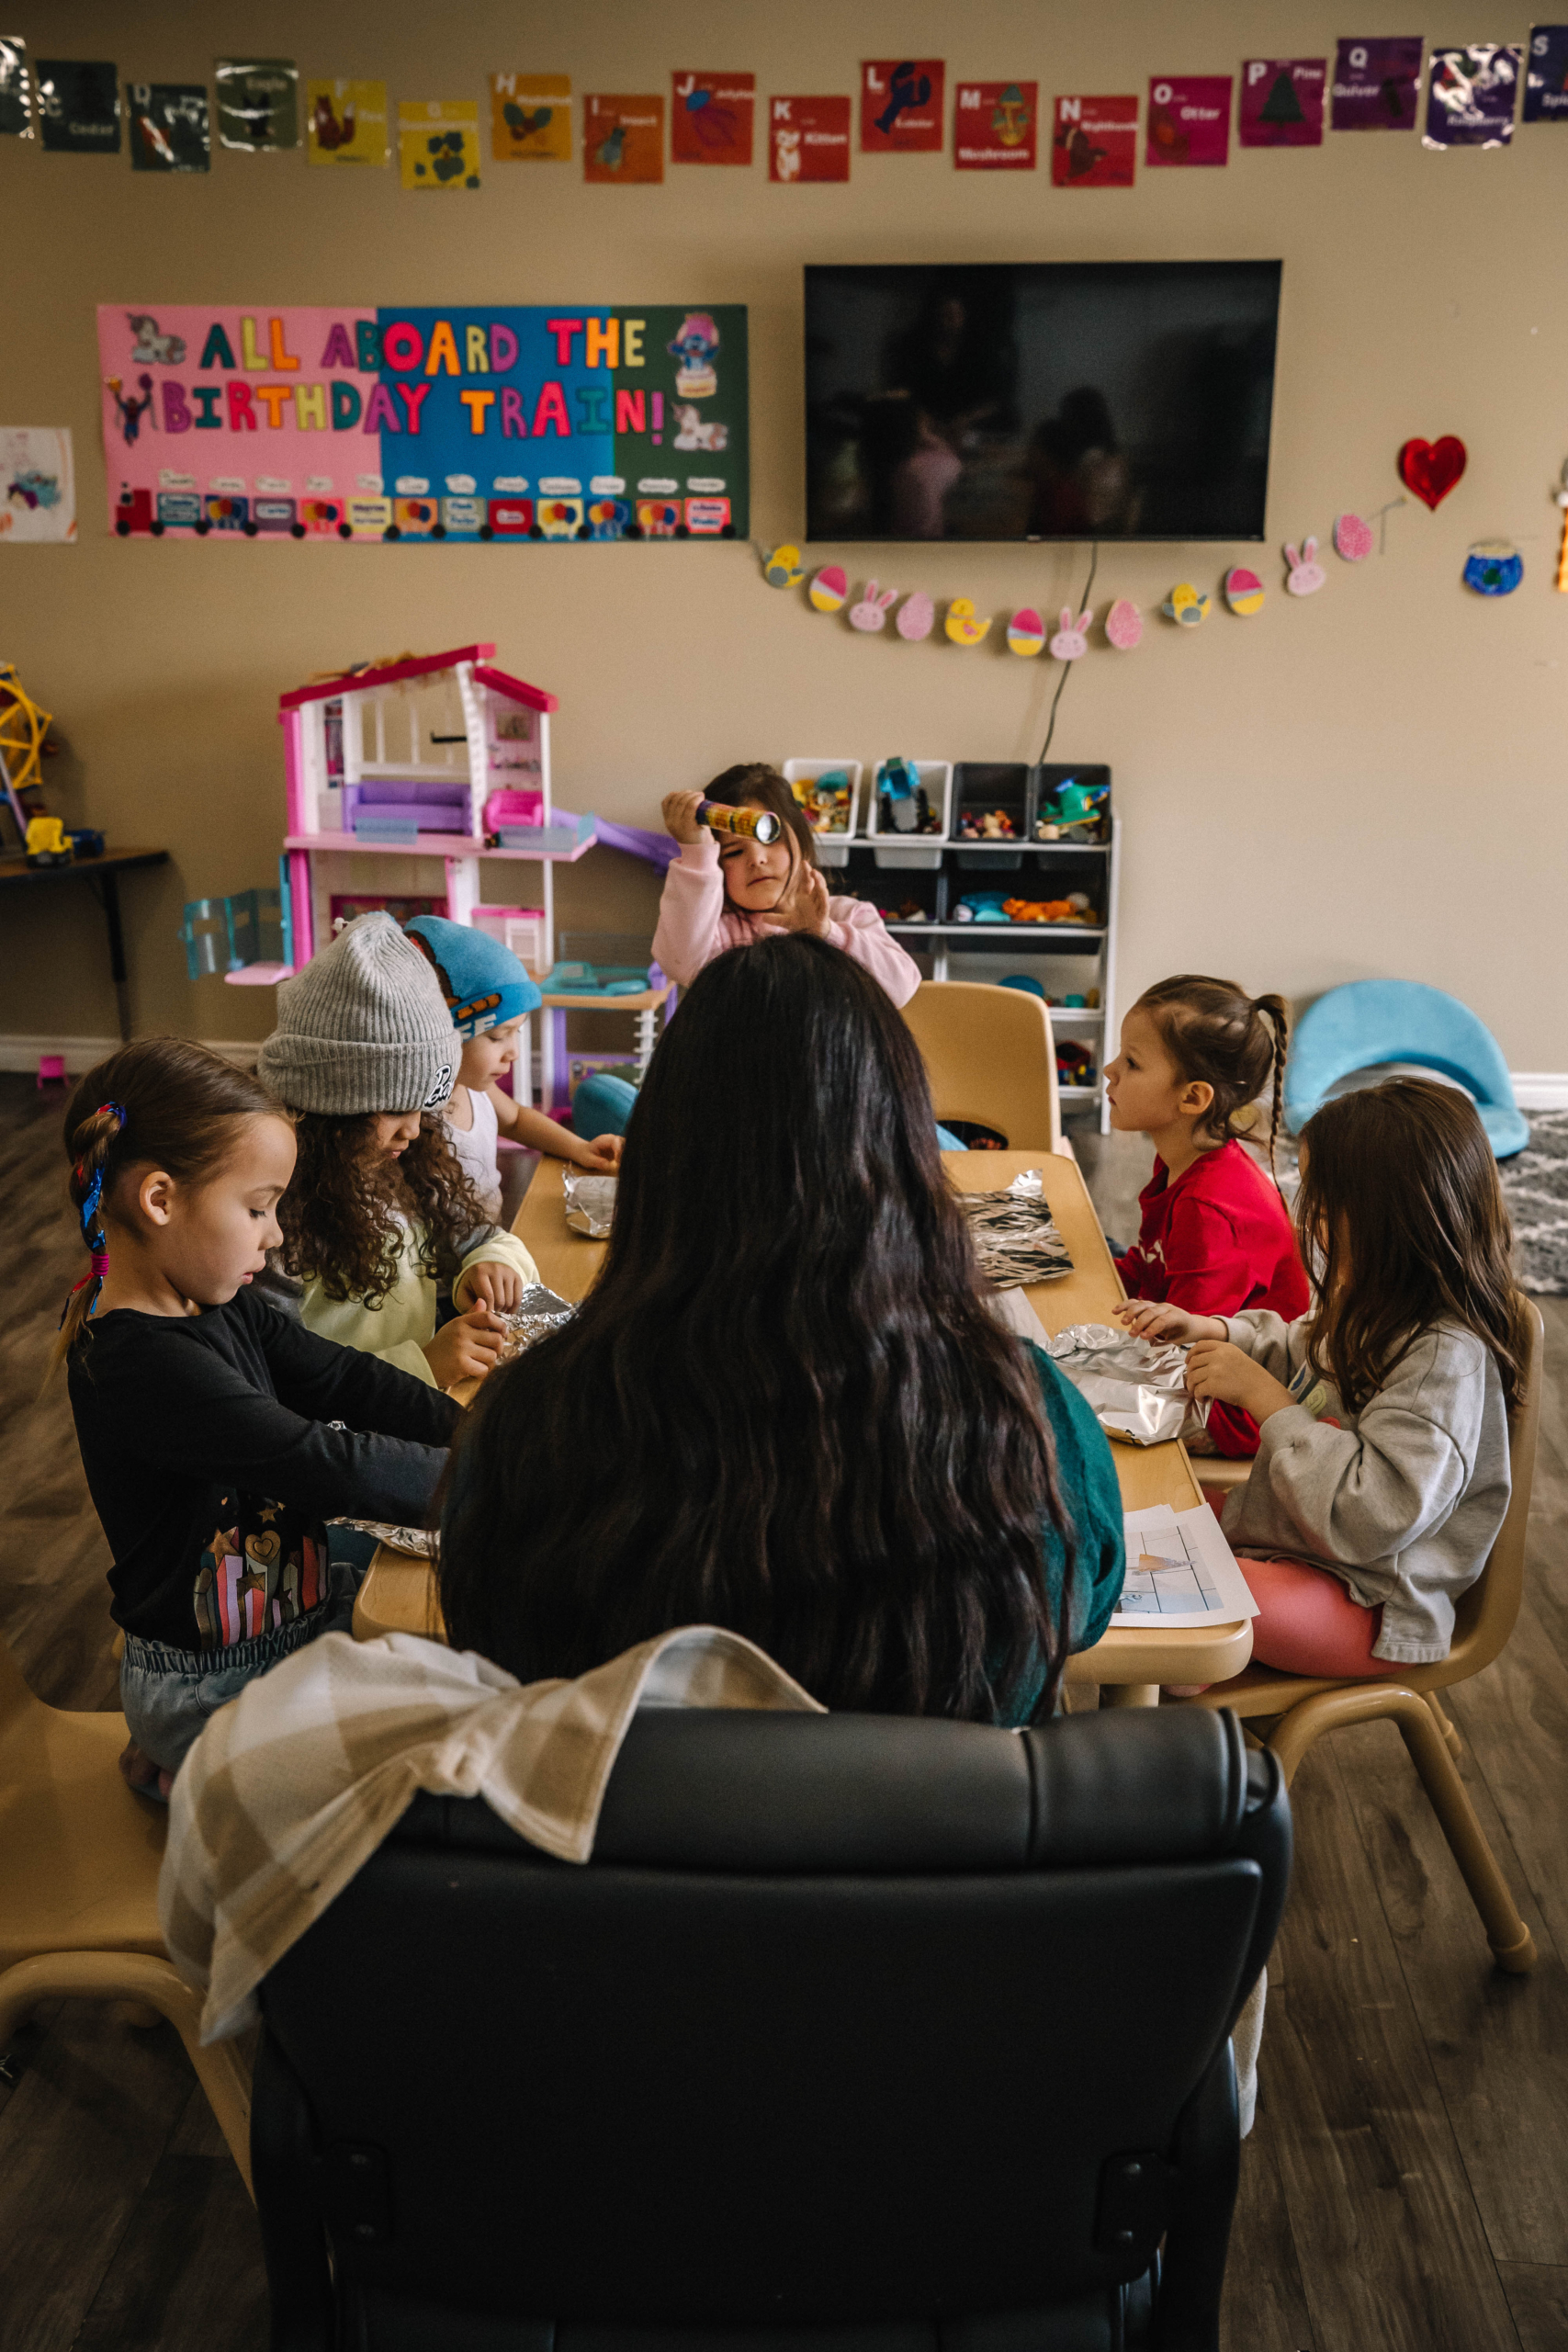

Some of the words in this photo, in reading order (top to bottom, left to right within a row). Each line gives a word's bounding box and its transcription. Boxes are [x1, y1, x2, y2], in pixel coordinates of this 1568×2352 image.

[1532, 35, 1550, 57] S
[1348, 47, 1369, 70] Q
[868, 66, 885, 90] L
[1248, 61, 1268, 86] P
[1293, 67, 1323, 80] Pine
[496, 74, 515, 96] H
[677, 75, 695, 96] J
[1154, 84, 1173, 104] O
[960, 89, 981, 109] M
[1060, 97, 1081, 121] N
[773, 100, 791, 120] K
[1179, 105, 1221, 121] Otter
[804, 133, 847, 145] Kitten
[959, 147, 1030, 160] Mushroom
[199, 316, 299, 372] ALL
[319, 318, 520, 378] ABOARD
[547, 316, 647, 368] THE
[161, 379, 432, 436] BIRTHDAY
[460, 379, 665, 447] TRAIN!
